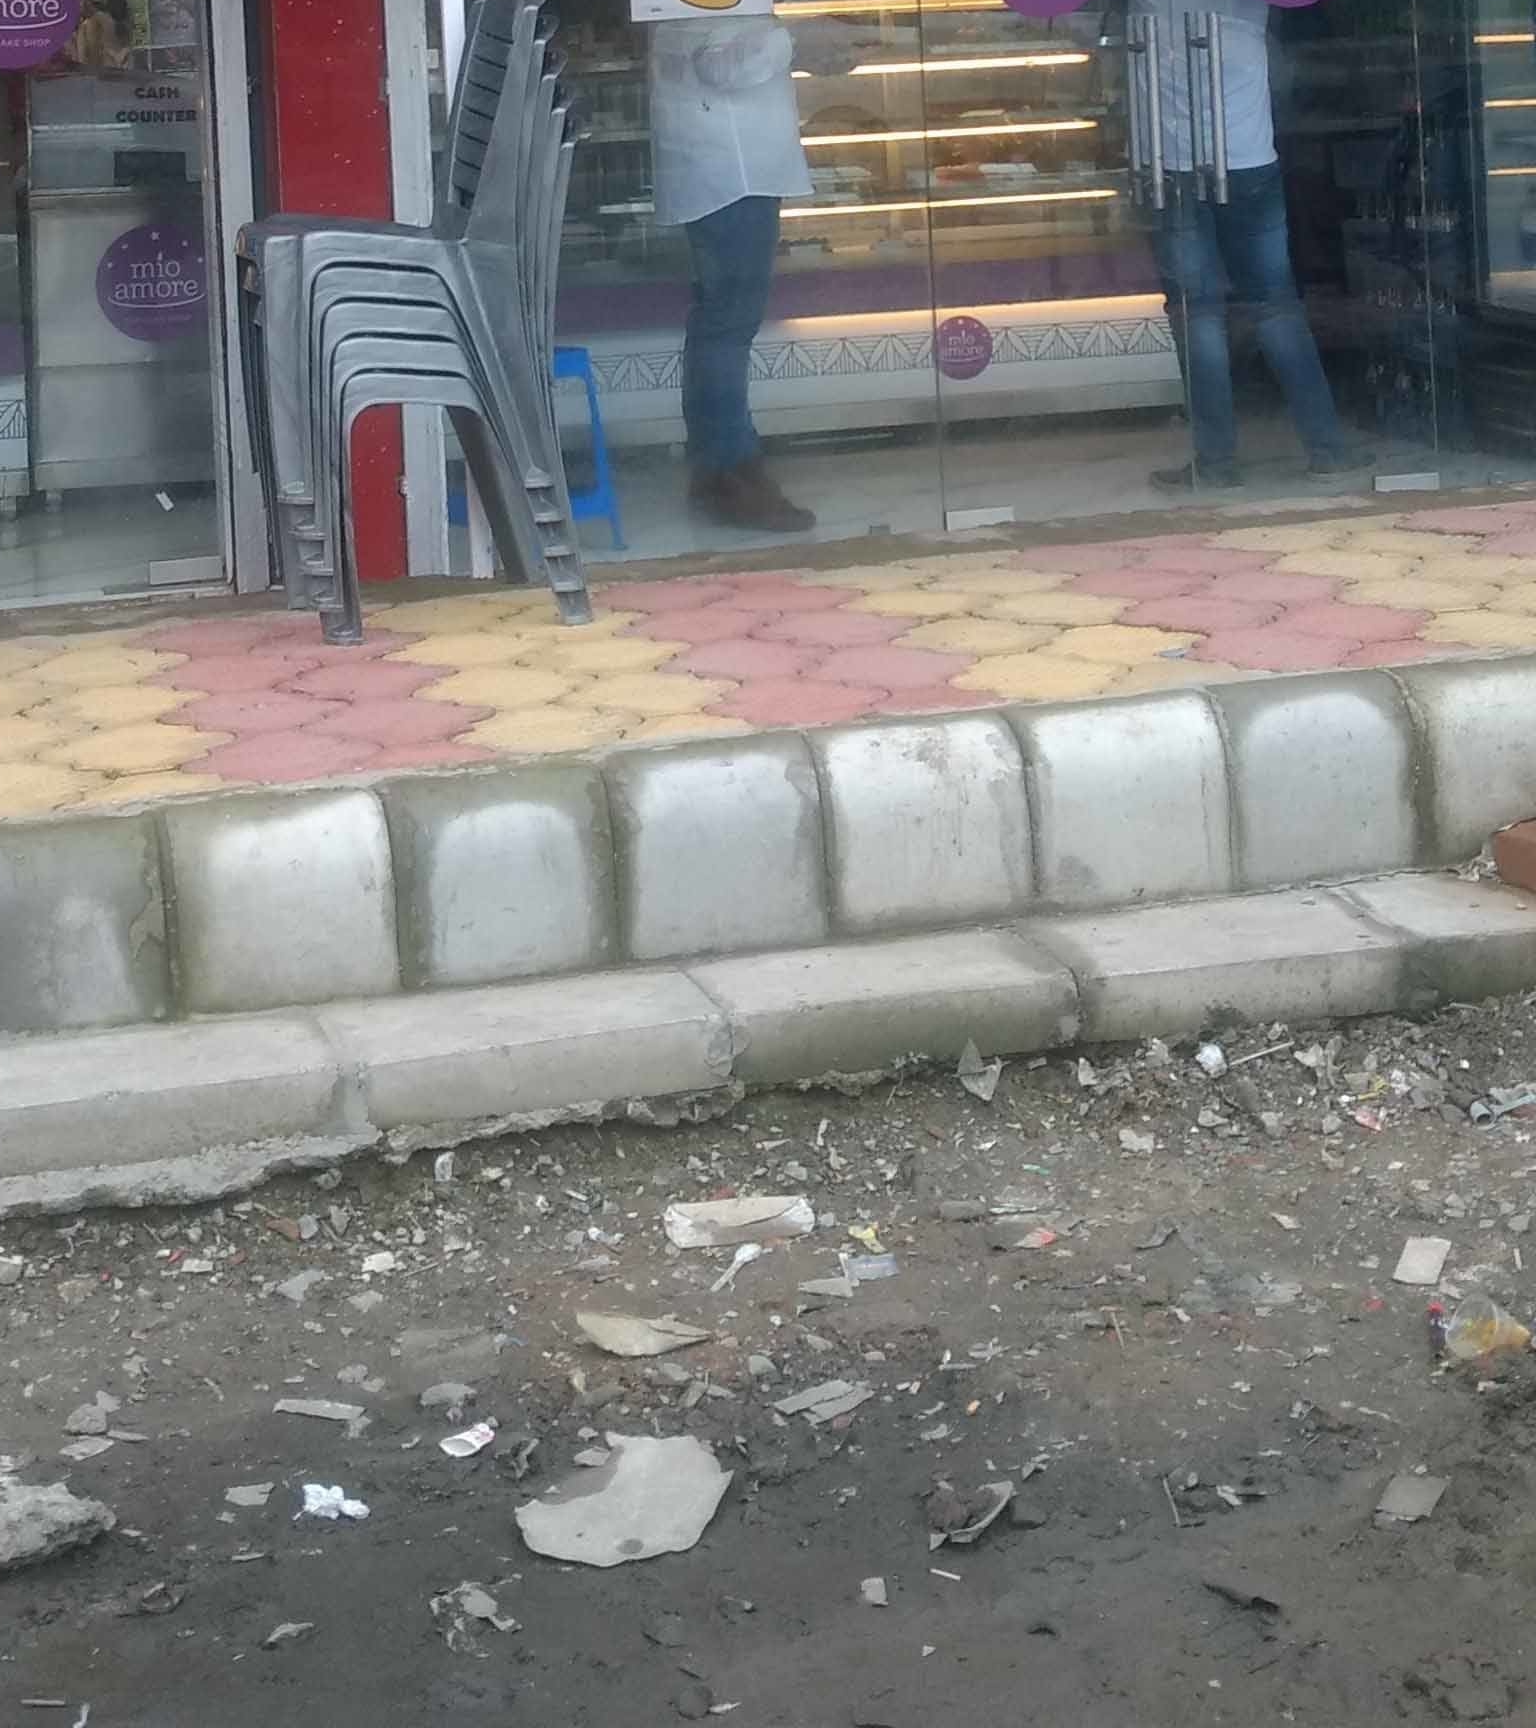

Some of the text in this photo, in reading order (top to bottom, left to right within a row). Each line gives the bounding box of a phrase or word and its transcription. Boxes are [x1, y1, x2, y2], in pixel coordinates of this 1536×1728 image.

[23, 38, 51, 48] SHOP
[115, 109, 199, 123] COUNTER
[129, 251, 181, 279] mio
[114, 279, 199, 301] amore
